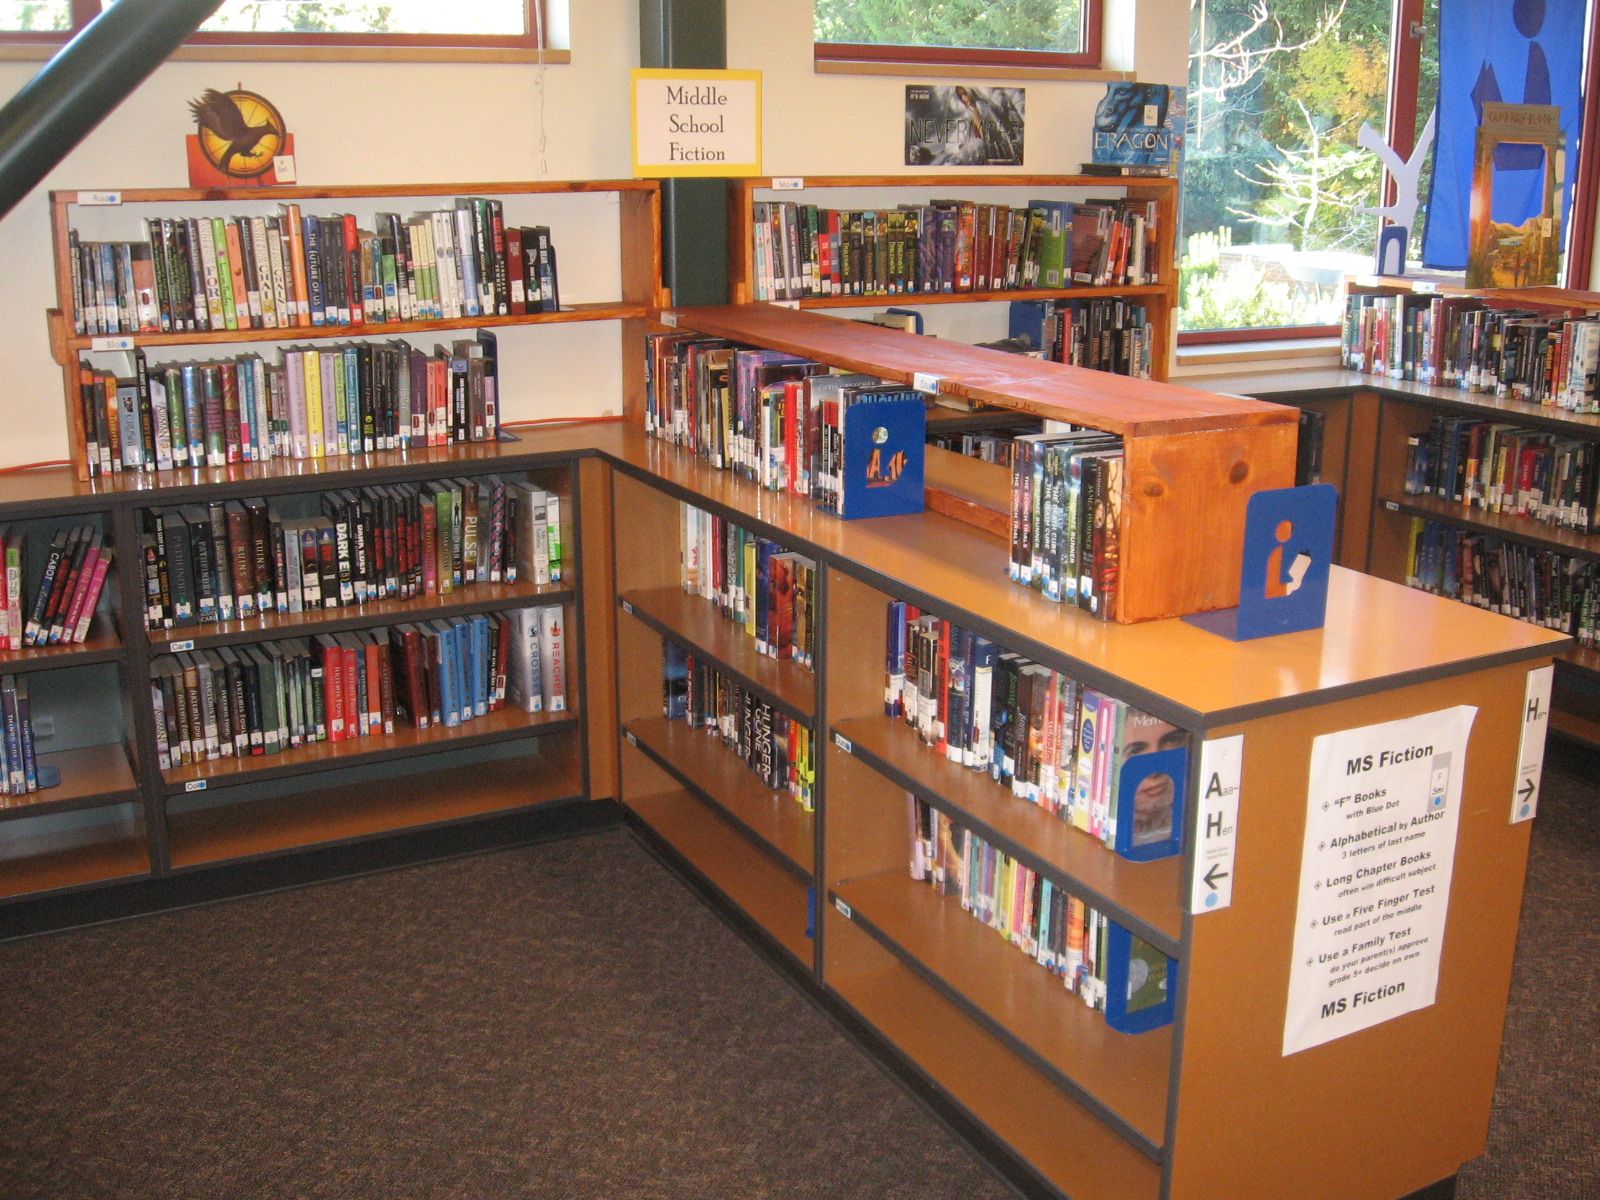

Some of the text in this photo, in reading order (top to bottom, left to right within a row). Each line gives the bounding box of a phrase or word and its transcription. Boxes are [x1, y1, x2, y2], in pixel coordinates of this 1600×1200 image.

[666, 86, 727, 105] Middle
[669, 114, 724, 132] School
[669, 142, 725, 160] Fiction
[1094, 131, 1168, 150] ERAGON
[539, 236, 548, 263] GREG BEAR
[307, 233, 320, 305] THE FUTURE OF US
[108, 416, 118, 448] Tangerine
[126, 415, 137, 447] CRUSA
[156, 405, 169, 437] AIRMAN
[336, 523, 348, 559] DARK
[465, 516, 477, 557] PULSE
[46, 553, 60, 580] CABOT
[173, 536, 185, 596] PATHFINDE
[198, 541, 208, 596] PATHFINDER
[238, 546, 247, 576] RUINS
[256, 540, 265, 569] RUINS
[178, 694, 186, 722] ARTEMIS
[190, 690, 199, 720] ARTEMIS
[206, 682, 215, 714] ARTEMIS
[221, 690, 229, 717] ARTEMIS
[236, 681, 247, 735] ARTEMIS FOWL
[7, 714, 15, 741] THINGS
[154, 710, 166, 740] AIRMAN
[762, 704, 772, 776] HUNGER
[1346, 745, 1433, 775] MS Fiction
[1346, 800, 1400, 820] with Blue Dot
[1354, 788, 1387, 804] Books
[1330, 810, 1445, 849] Alphabetical by Author
[1342, 831, 1426, 859] 3 letters of last name
[1326, 851, 1431, 887] Long Chapter Books
[1338, 864, 1436, 898] often with difficult subject
[1322, 913, 1343, 926] Use
[1353, 903, 1375, 917] Five
[1378, 892, 1410, 911] Finger
[1413, 885, 1435, 899] Test
[1334, 903, 1422, 936] read part of the middle
[1319, 927, 1411, 964] Use a Family Test
[1330, 937, 1429, 974] do your parent(s) approve
[1329, 951, 1420, 987] grade 5+ decide on own
[1321, 982, 1405, 1019] MS Fiction
